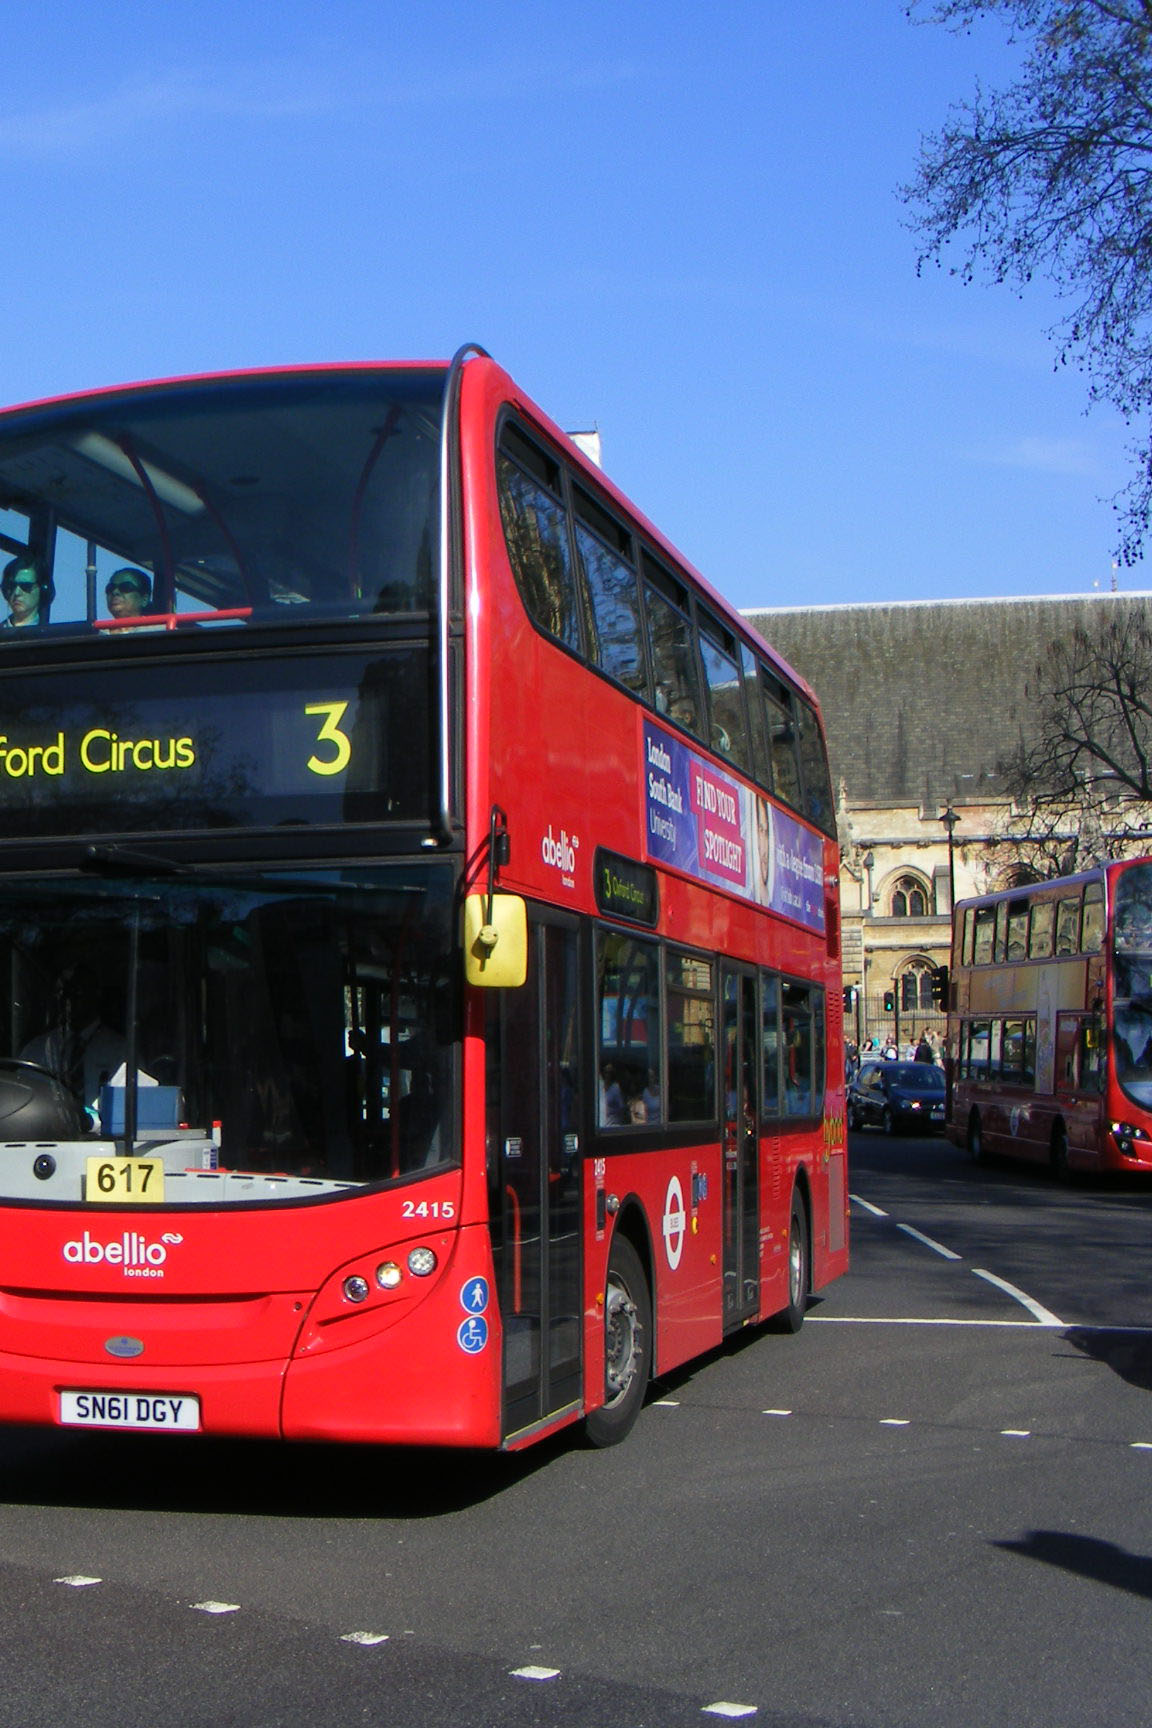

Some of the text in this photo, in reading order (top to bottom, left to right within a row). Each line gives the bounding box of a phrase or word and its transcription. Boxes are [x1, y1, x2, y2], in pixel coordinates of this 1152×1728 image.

[80, 728, 196, 773] Circus
[305, 701, 352, 776] 3
[647, 737, 671, 775] London
[649, 772, 683, 813] South Bank
[696, 776, 737, 825] FIND YOUR
[542, 824, 575, 873] abellio
[650, 807, 676, 851] University
[704, 829, 742, 873] SPOTLIGHT
[604, 868, 612, 898] 3
[97, 1163, 155, 1193] 617
[402, 1201, 455, 1218] 2415
[63, 1230, 167, 1265] abellio
[124, 1267, 164, 1278] london
[76, 1396, 183, 1423] SN61 DGY
